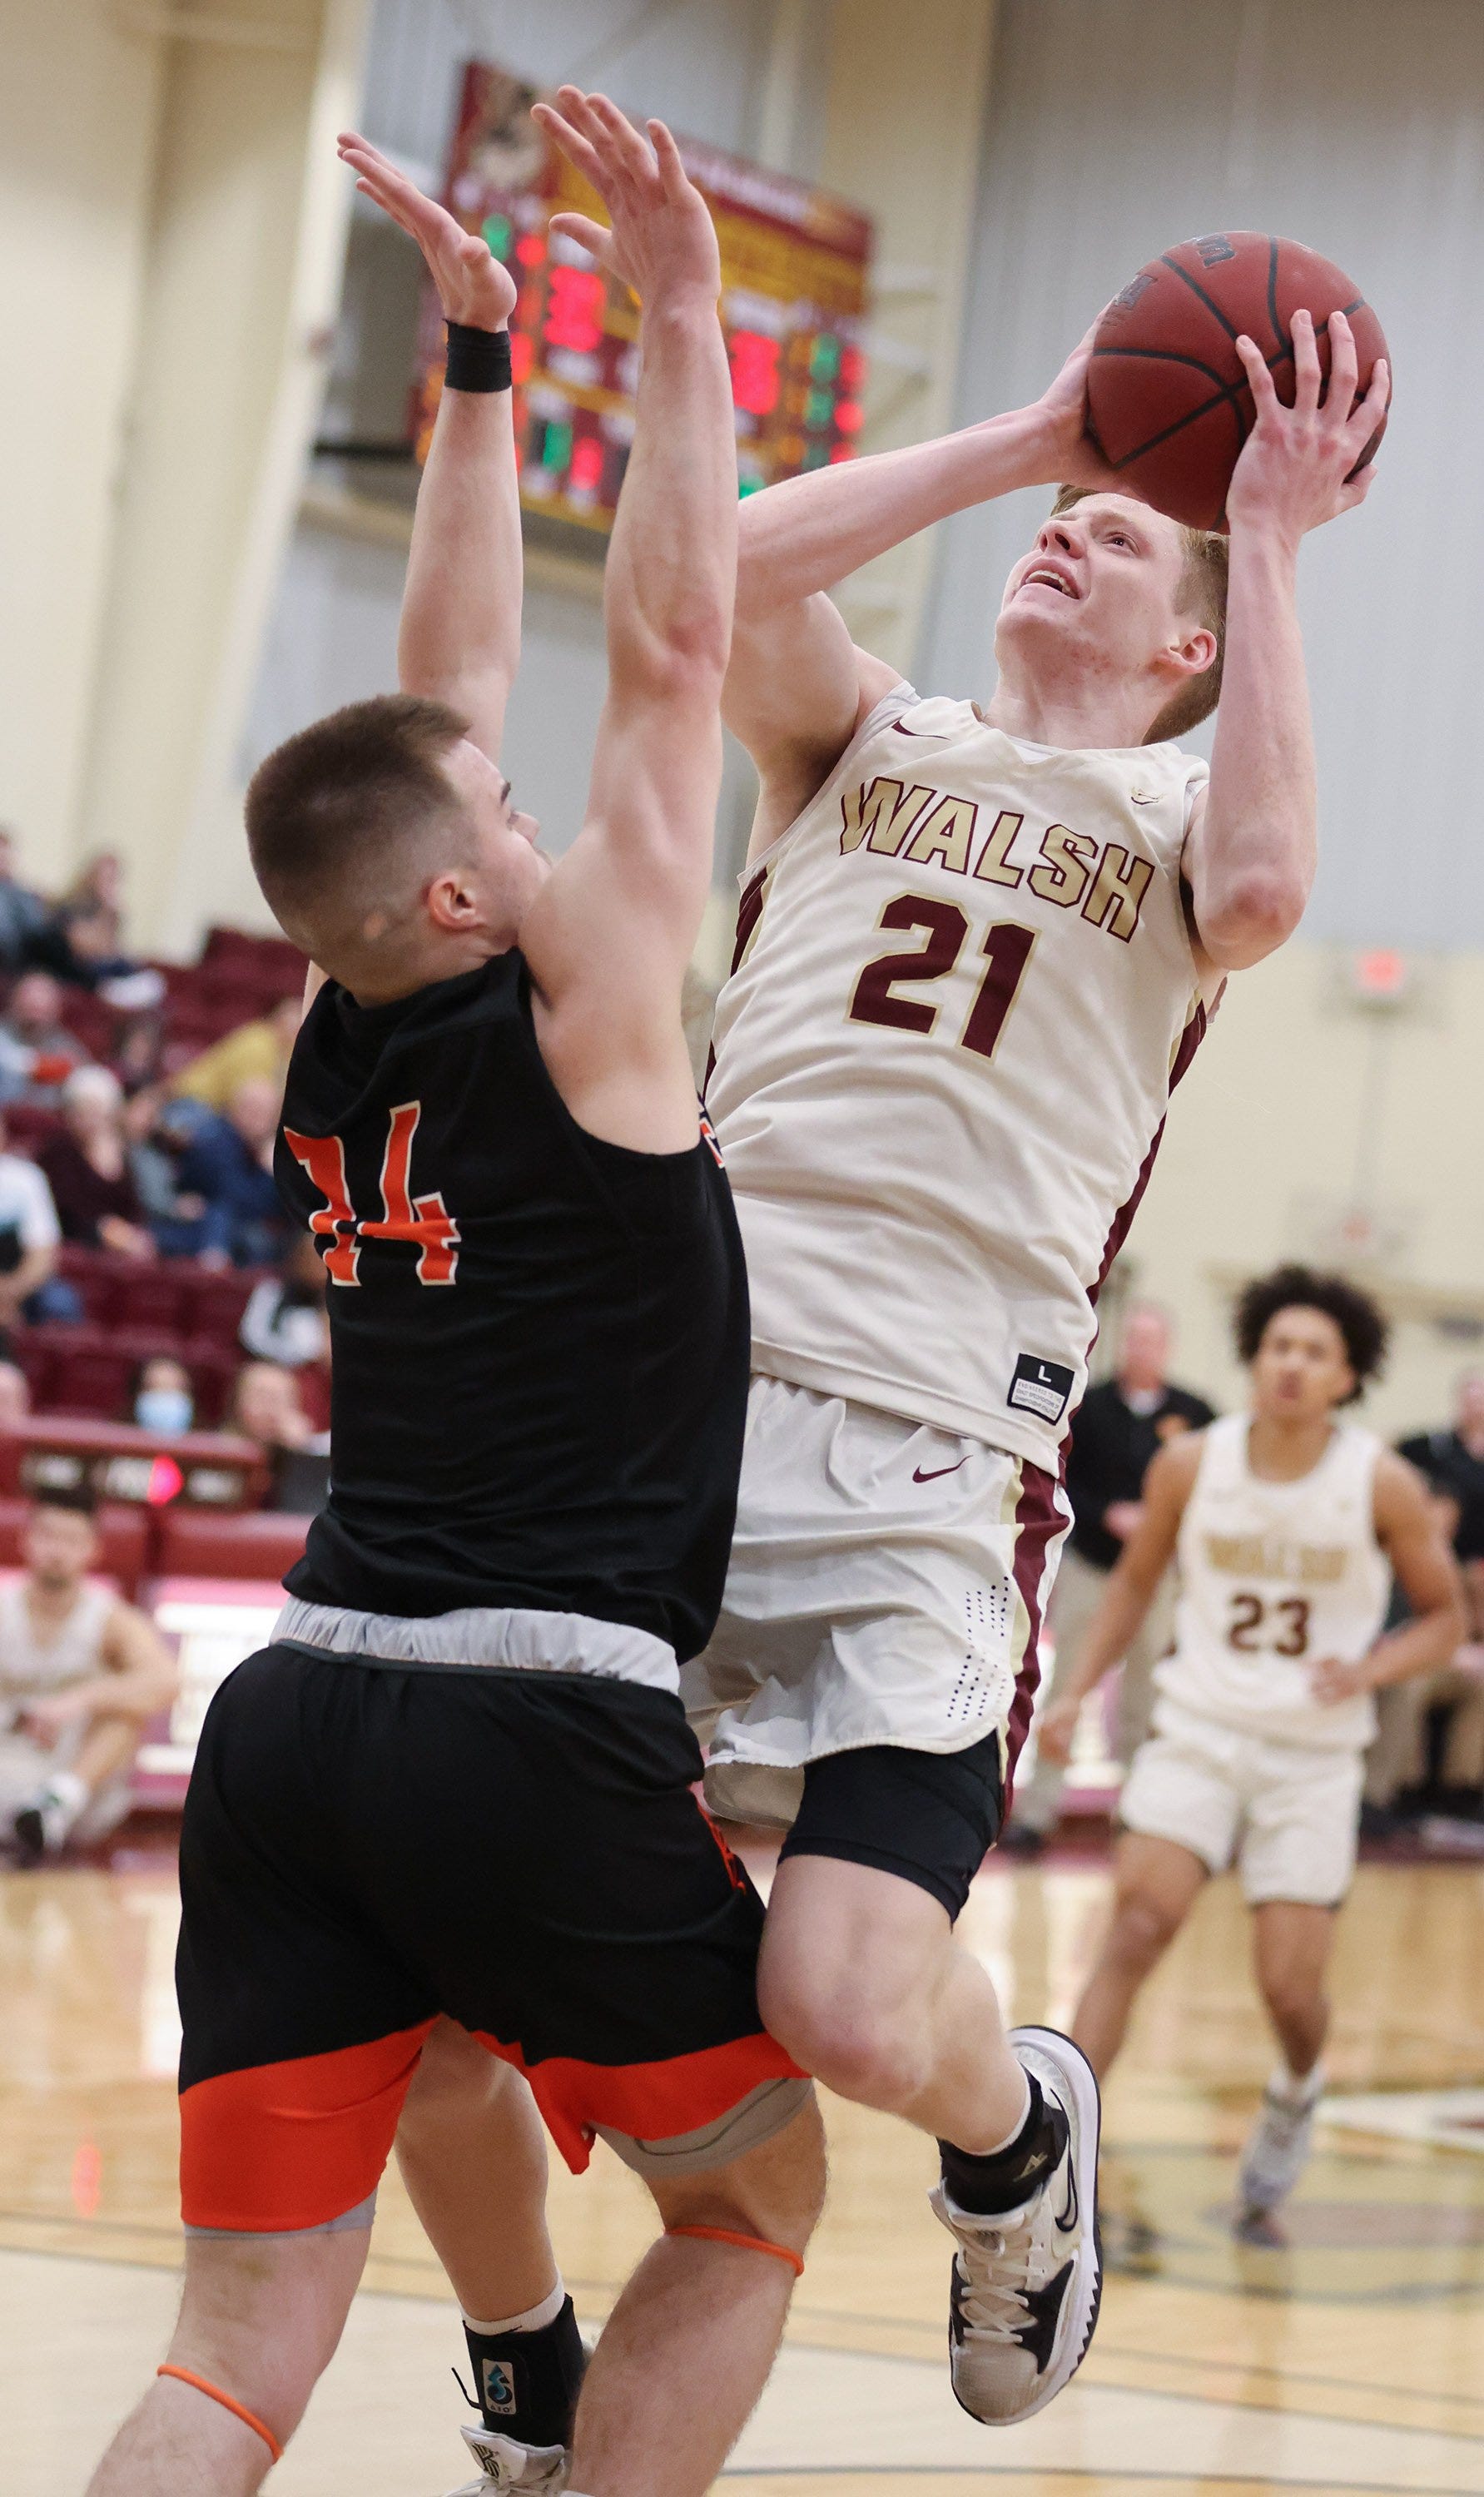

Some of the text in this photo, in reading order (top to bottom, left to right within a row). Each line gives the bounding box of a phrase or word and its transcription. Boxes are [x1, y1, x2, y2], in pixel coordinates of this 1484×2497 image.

[840, 777, 1156, 944] WALSH
[844, 890, 1042, 1065] 21
[1038, 1365, 1052, 1383] L
[1226, 1593, 1311, 1656] 23
